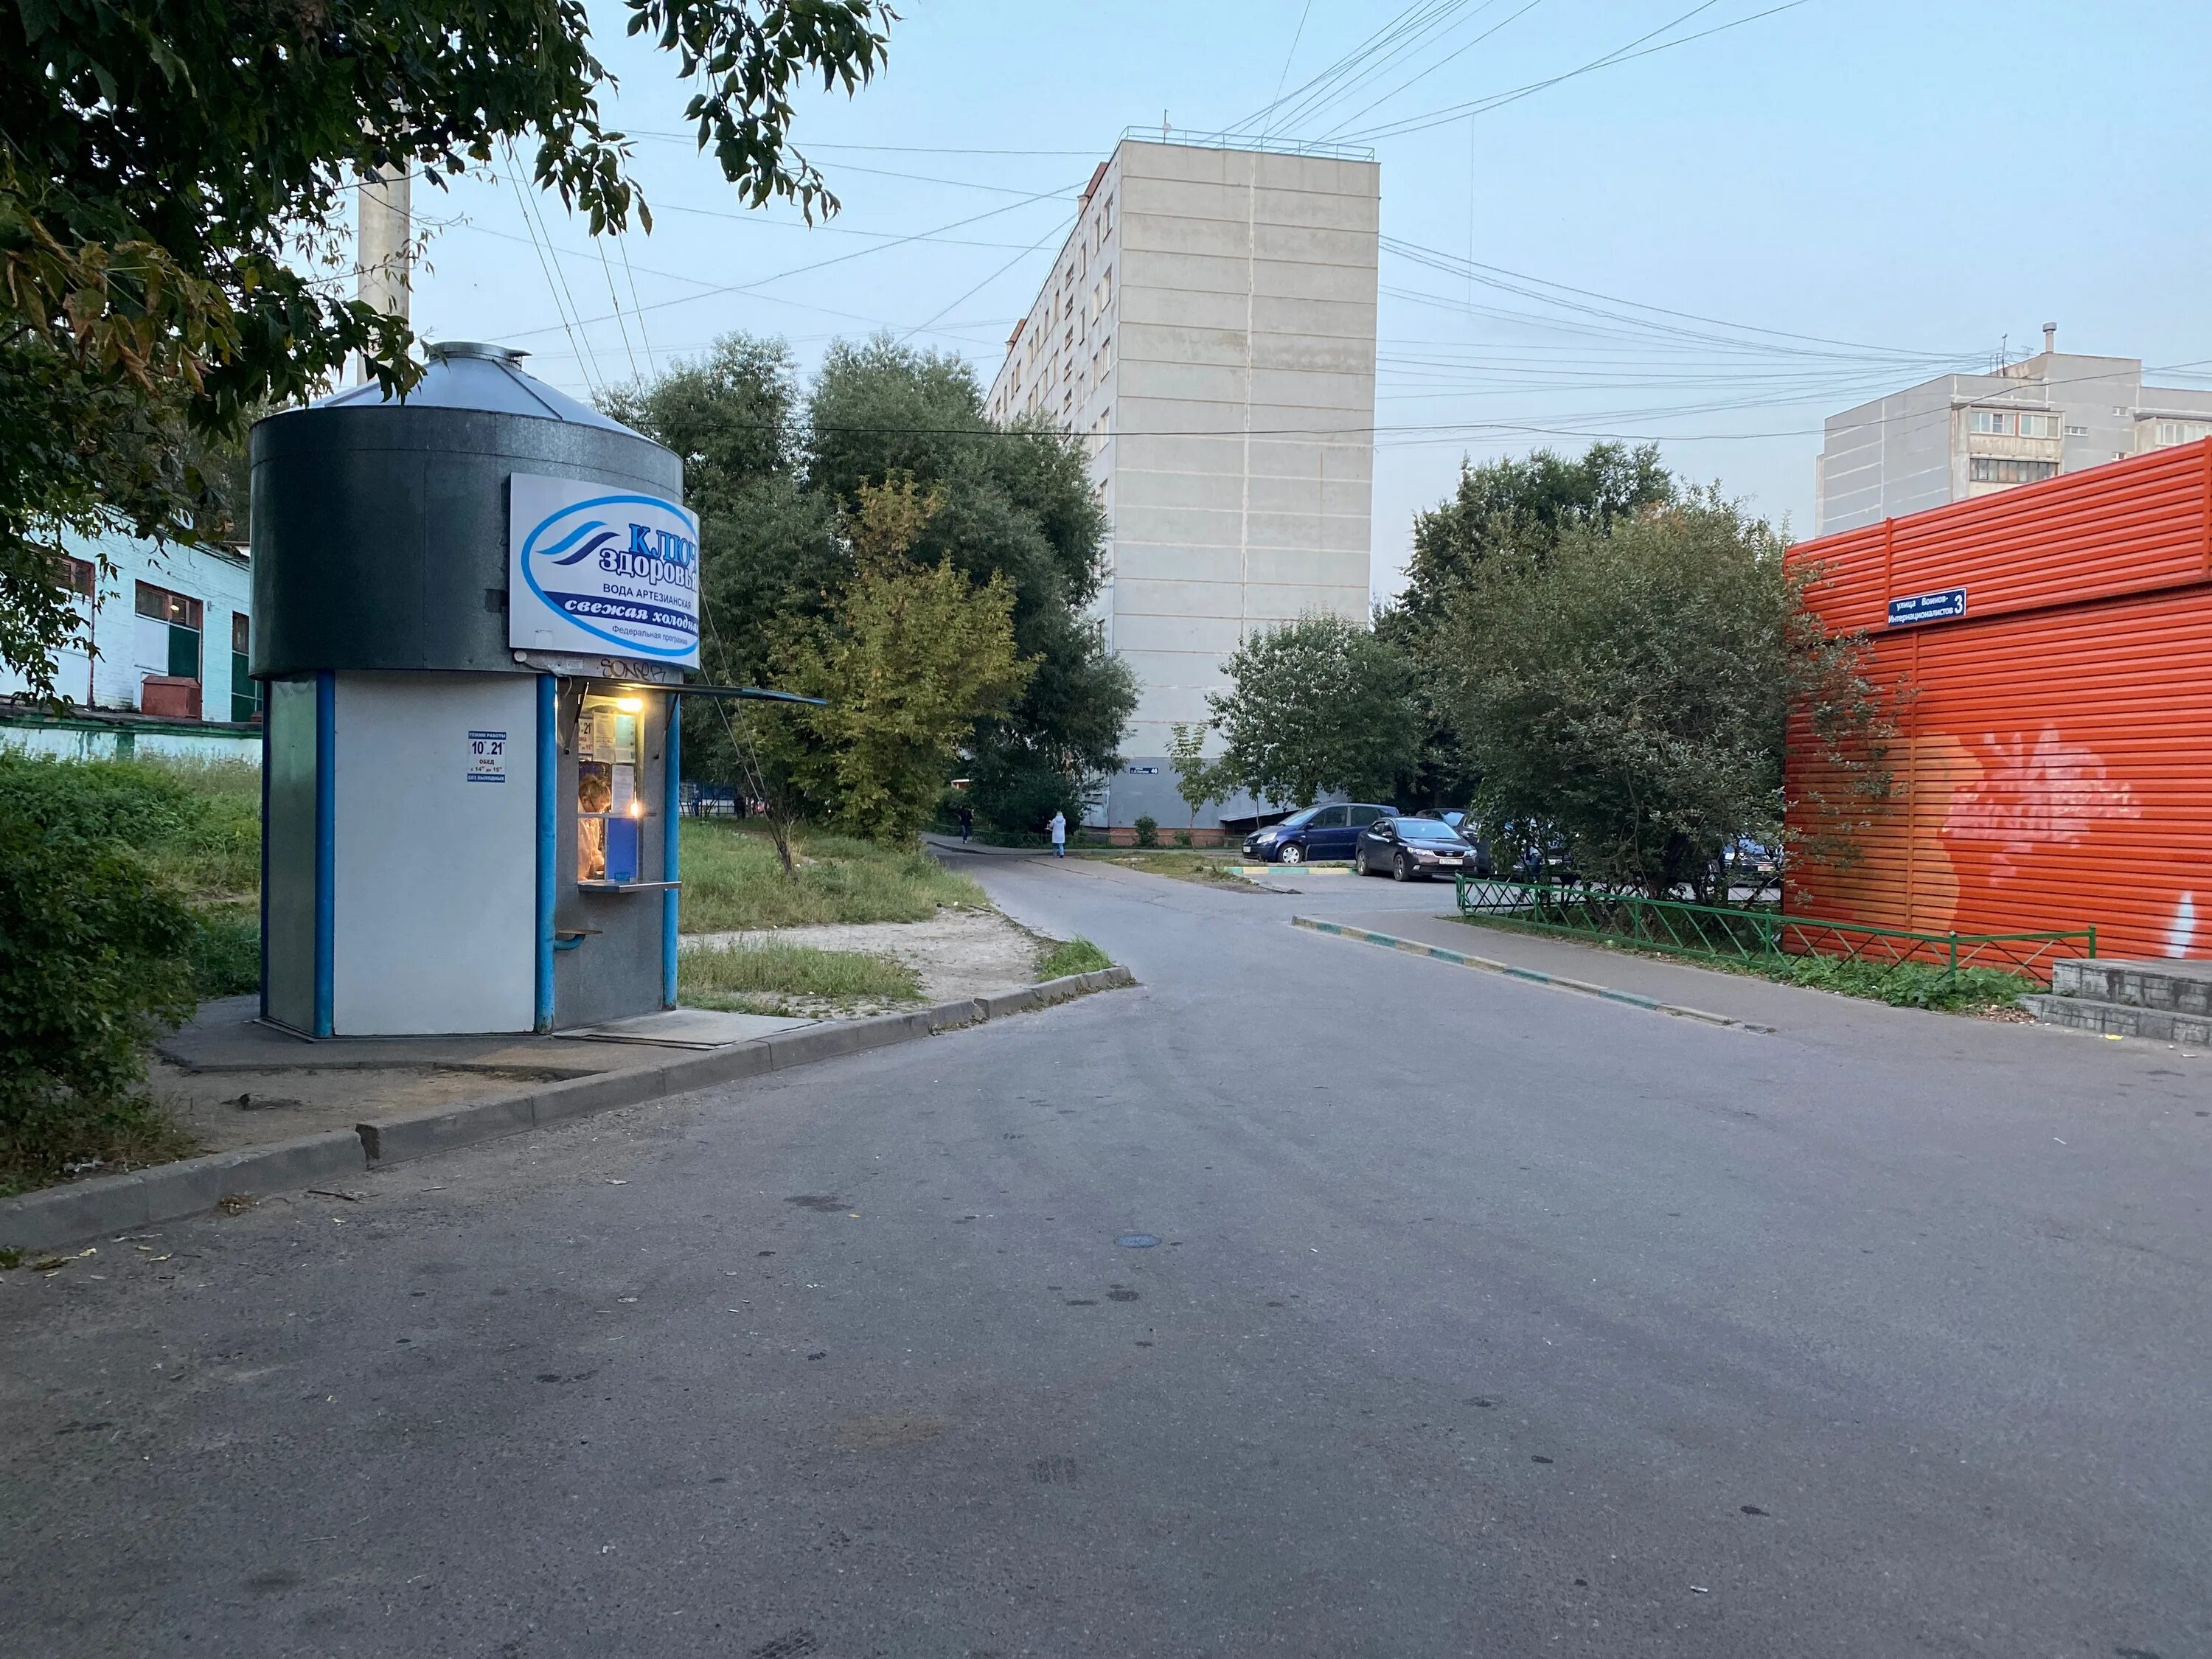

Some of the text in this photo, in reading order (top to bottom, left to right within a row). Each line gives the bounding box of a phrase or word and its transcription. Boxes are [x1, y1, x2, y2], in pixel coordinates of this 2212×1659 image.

[603, 583, 692, 610] ВОДА АРТЕЗИАНСКАЯ
[1896, 594, 1963, 614] улица Воинов- 3
[564, 599, 649, 620] свежая
[1888, 607, 1954, 624] Интернационалистов
[612, 625, 661, 640] Федеральная
